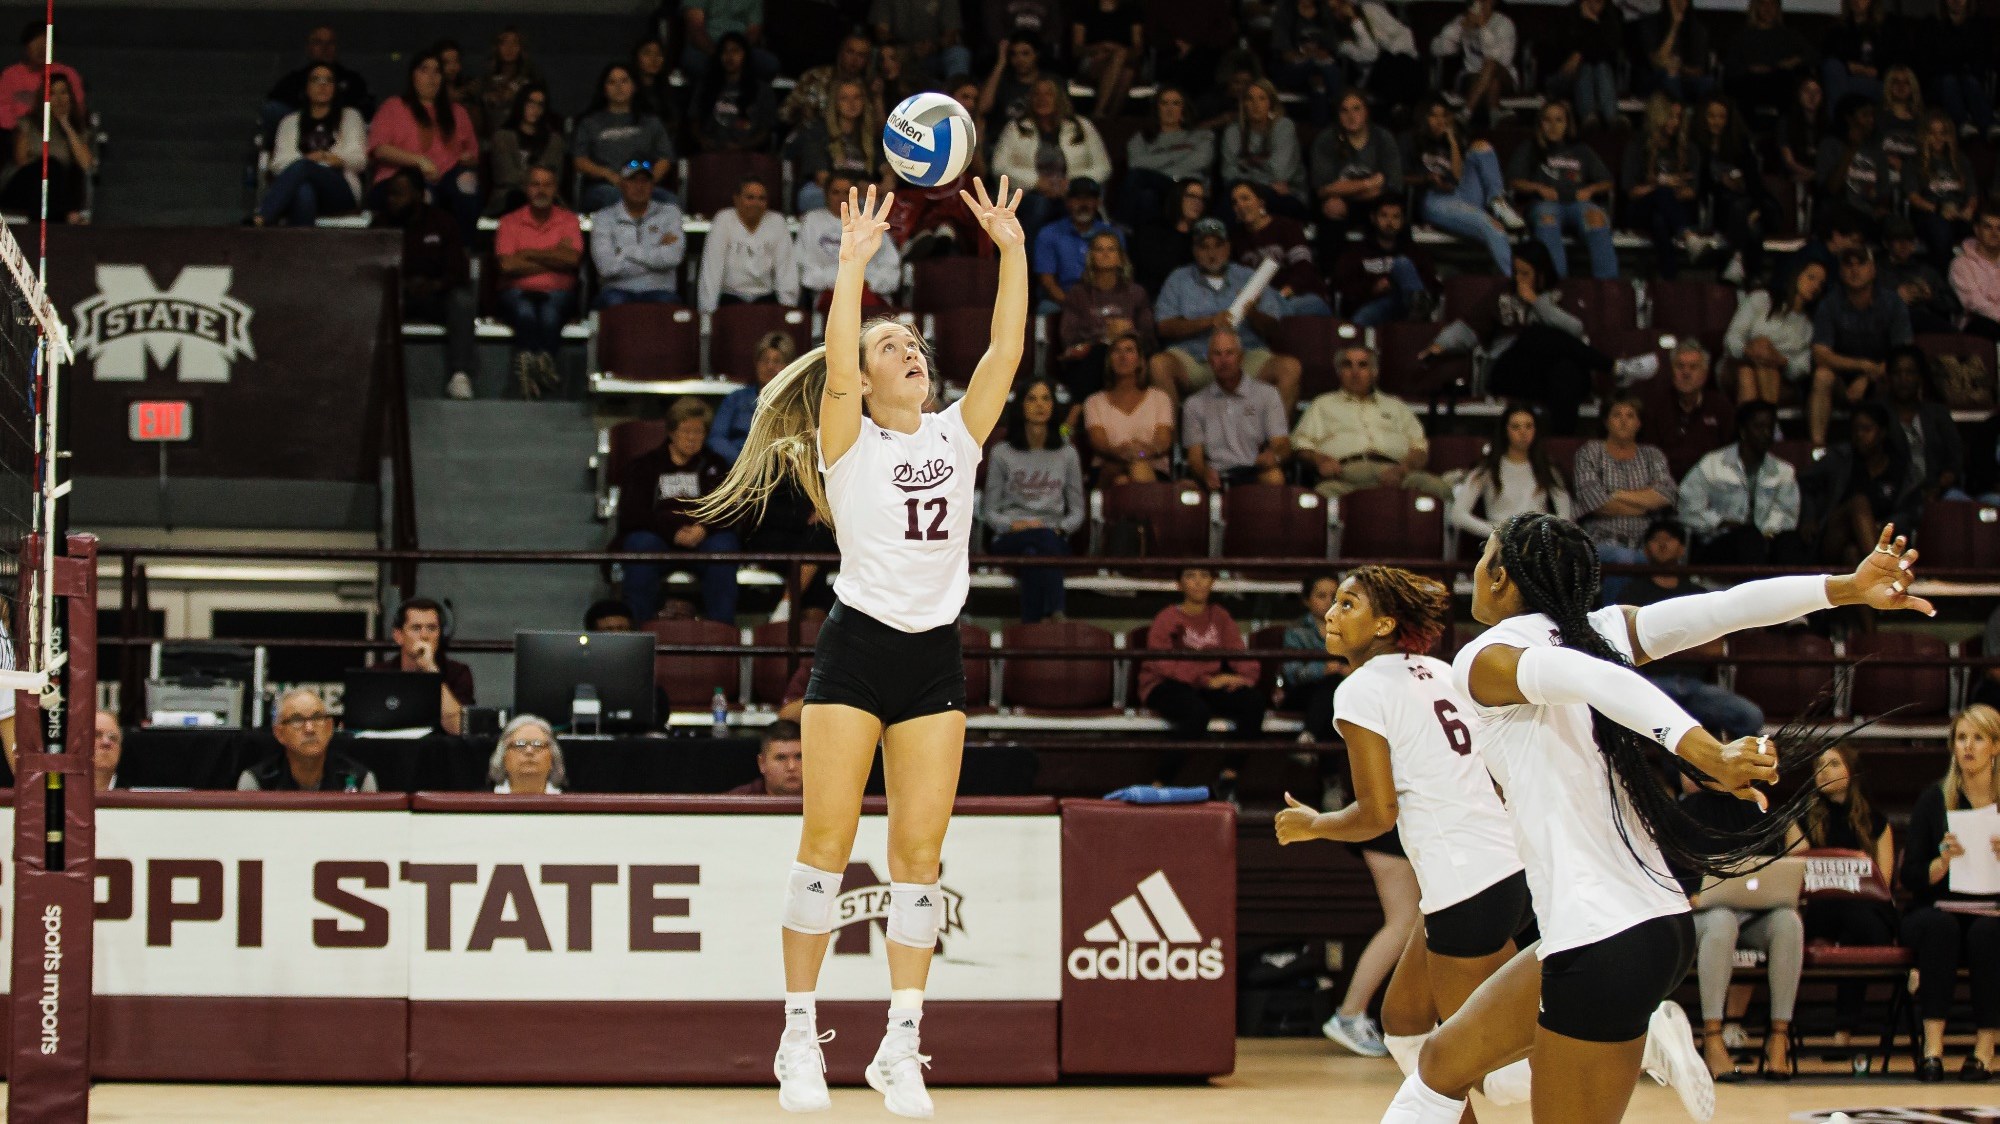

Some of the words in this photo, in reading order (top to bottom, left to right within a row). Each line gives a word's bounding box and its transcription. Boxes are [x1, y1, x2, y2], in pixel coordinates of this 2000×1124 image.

[888, 114, 923, 142] molten
[105, 302, 220, 339] STATE
[138, 403, 185, 439] EXIT
[891, 459, 954, 493] Sate
[904, 497, 949, 541] 12
[1434, 699, 1472, 756] 6
[0, 859, 263, 948] PPI
[312, 861, 701, 952] STATE
[806, 885, 825, 894] adidas
[840, 890, 892, 919] STA
[41, 904, 63, 971] sports
[1067, 938, 1225, 981] adidas
[38, 973, 60, 1055] imports
